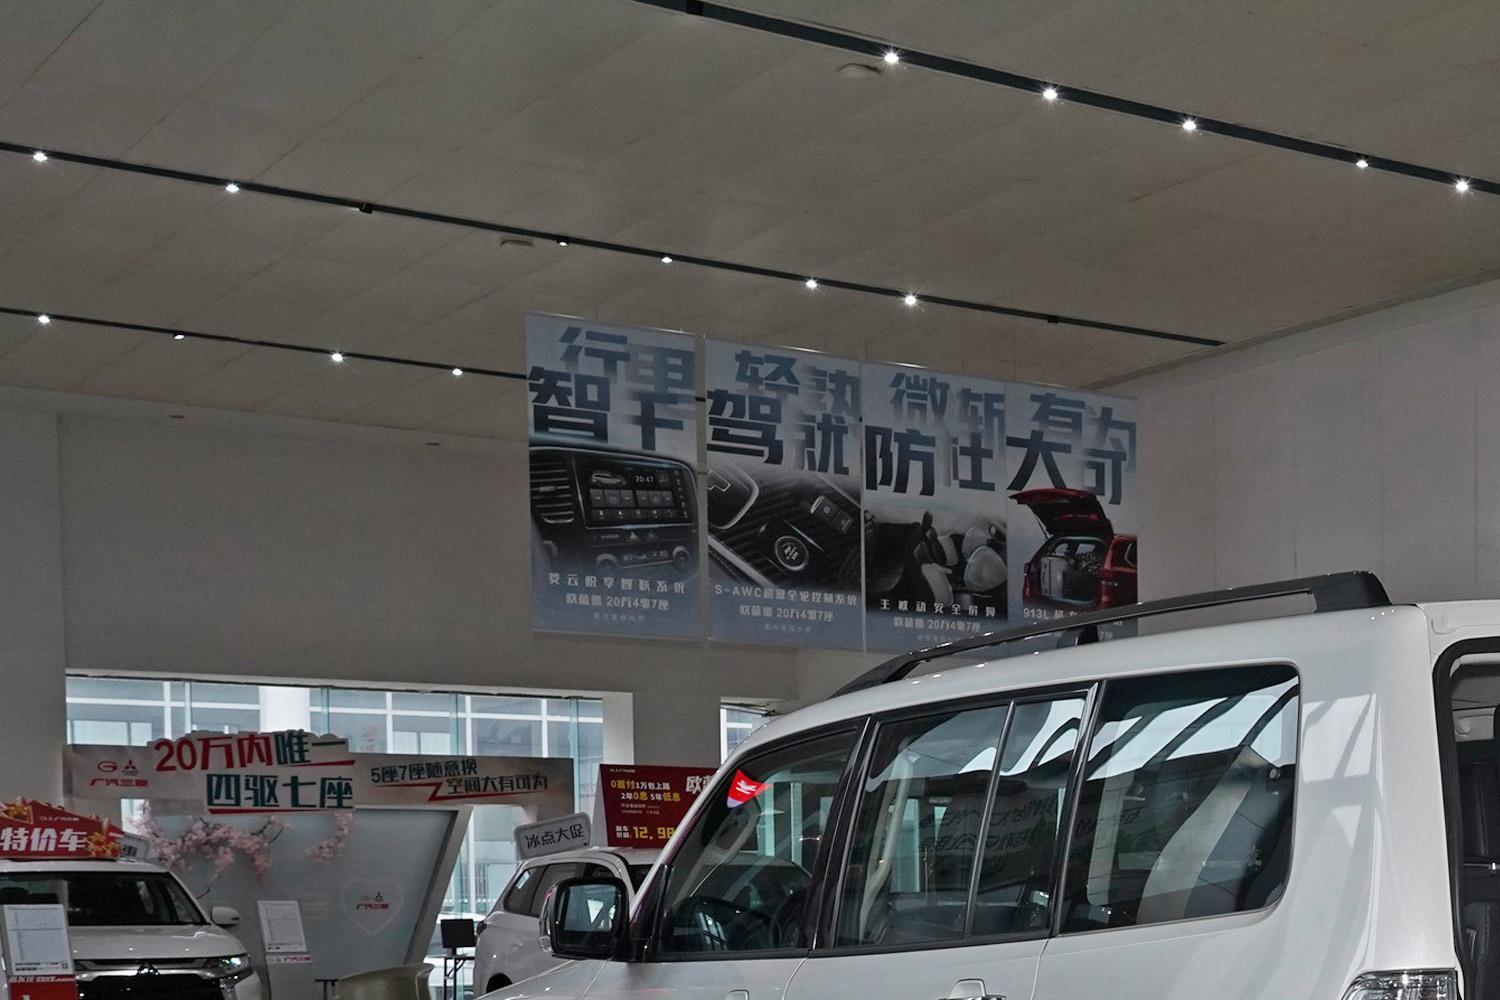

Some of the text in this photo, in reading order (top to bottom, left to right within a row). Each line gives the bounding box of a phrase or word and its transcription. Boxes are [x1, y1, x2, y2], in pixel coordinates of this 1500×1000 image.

[154, 730, 346, 772] 20万内唯一
[371, 758, 477, 783] 5座7座随意换
[206, 773, 353, 808] 四驱七座
[446, 774, 548, 795] 空间大有可为
[0, 827, 87, 852] 特价车
[525, 823, 584, 849] 冰点大促
